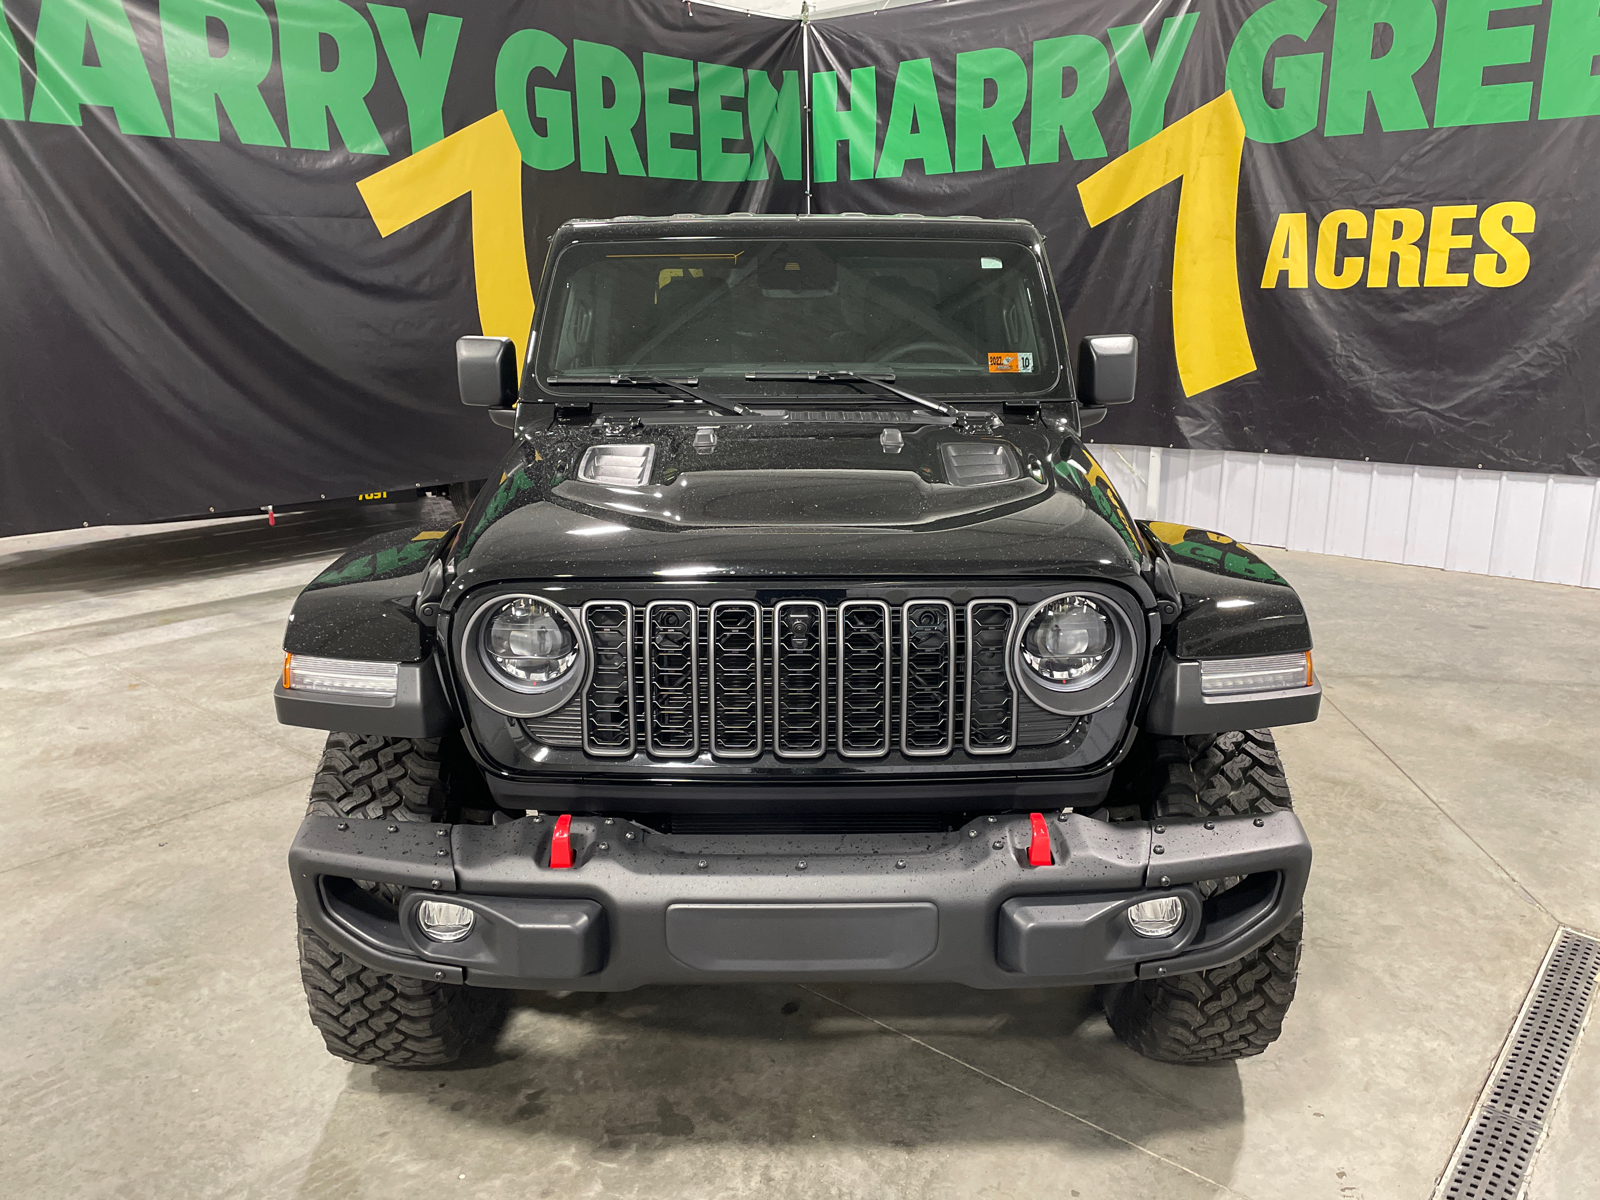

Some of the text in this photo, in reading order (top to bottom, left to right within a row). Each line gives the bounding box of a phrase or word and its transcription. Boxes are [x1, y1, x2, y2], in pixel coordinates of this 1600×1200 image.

[495, 28, 803, 182] GREEN
[812, 11, 1200, 183] HARRY
[356, 109, 536, 400] 7
[1076, 89, 1537, 398] 7 ACRES
[1021, 357, 1030, 368] 10
